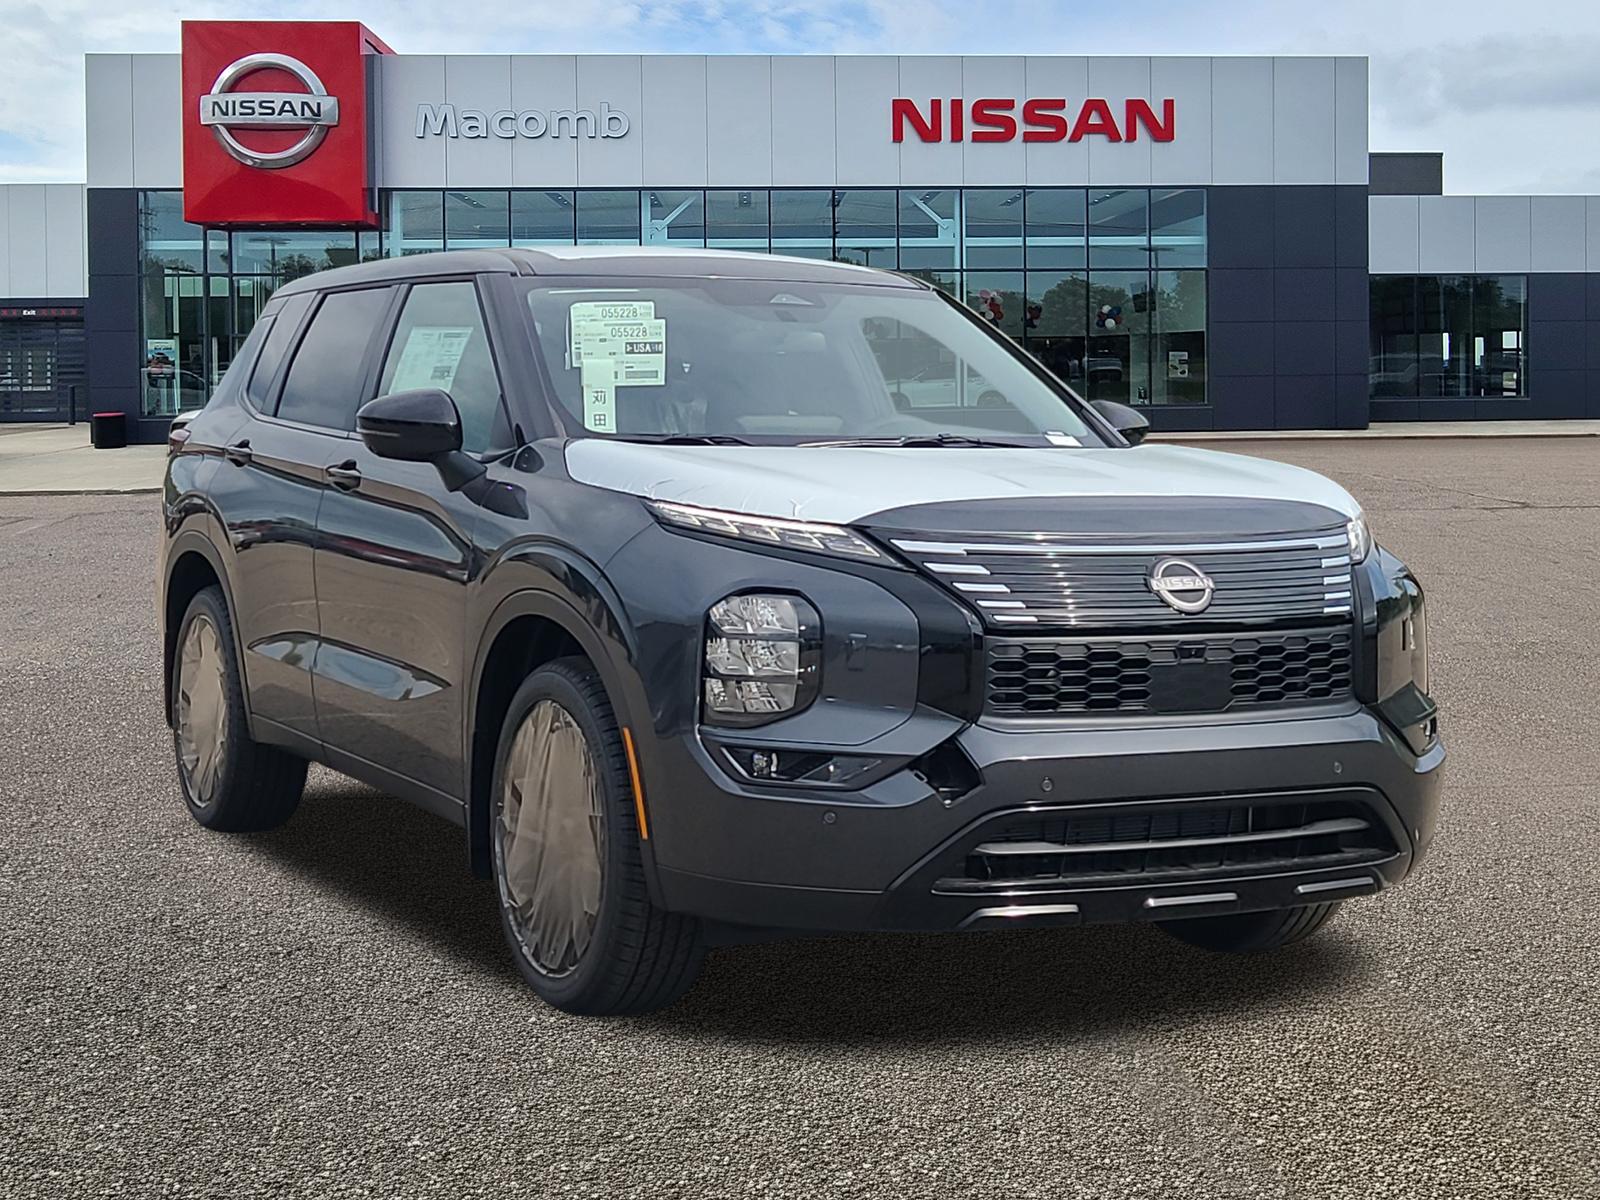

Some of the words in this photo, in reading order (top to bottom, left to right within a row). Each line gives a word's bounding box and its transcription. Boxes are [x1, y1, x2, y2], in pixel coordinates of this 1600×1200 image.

[211, 100, 321, 117] NISSAN
[415, 102, 630, 139] Macomb
[892, 98, 1175, 142] NISSAN
[601, 307, 638, 318] 055228
[611, 327, 647, 337] 055228
[1152, 577, 1214, 590] NISSAN
